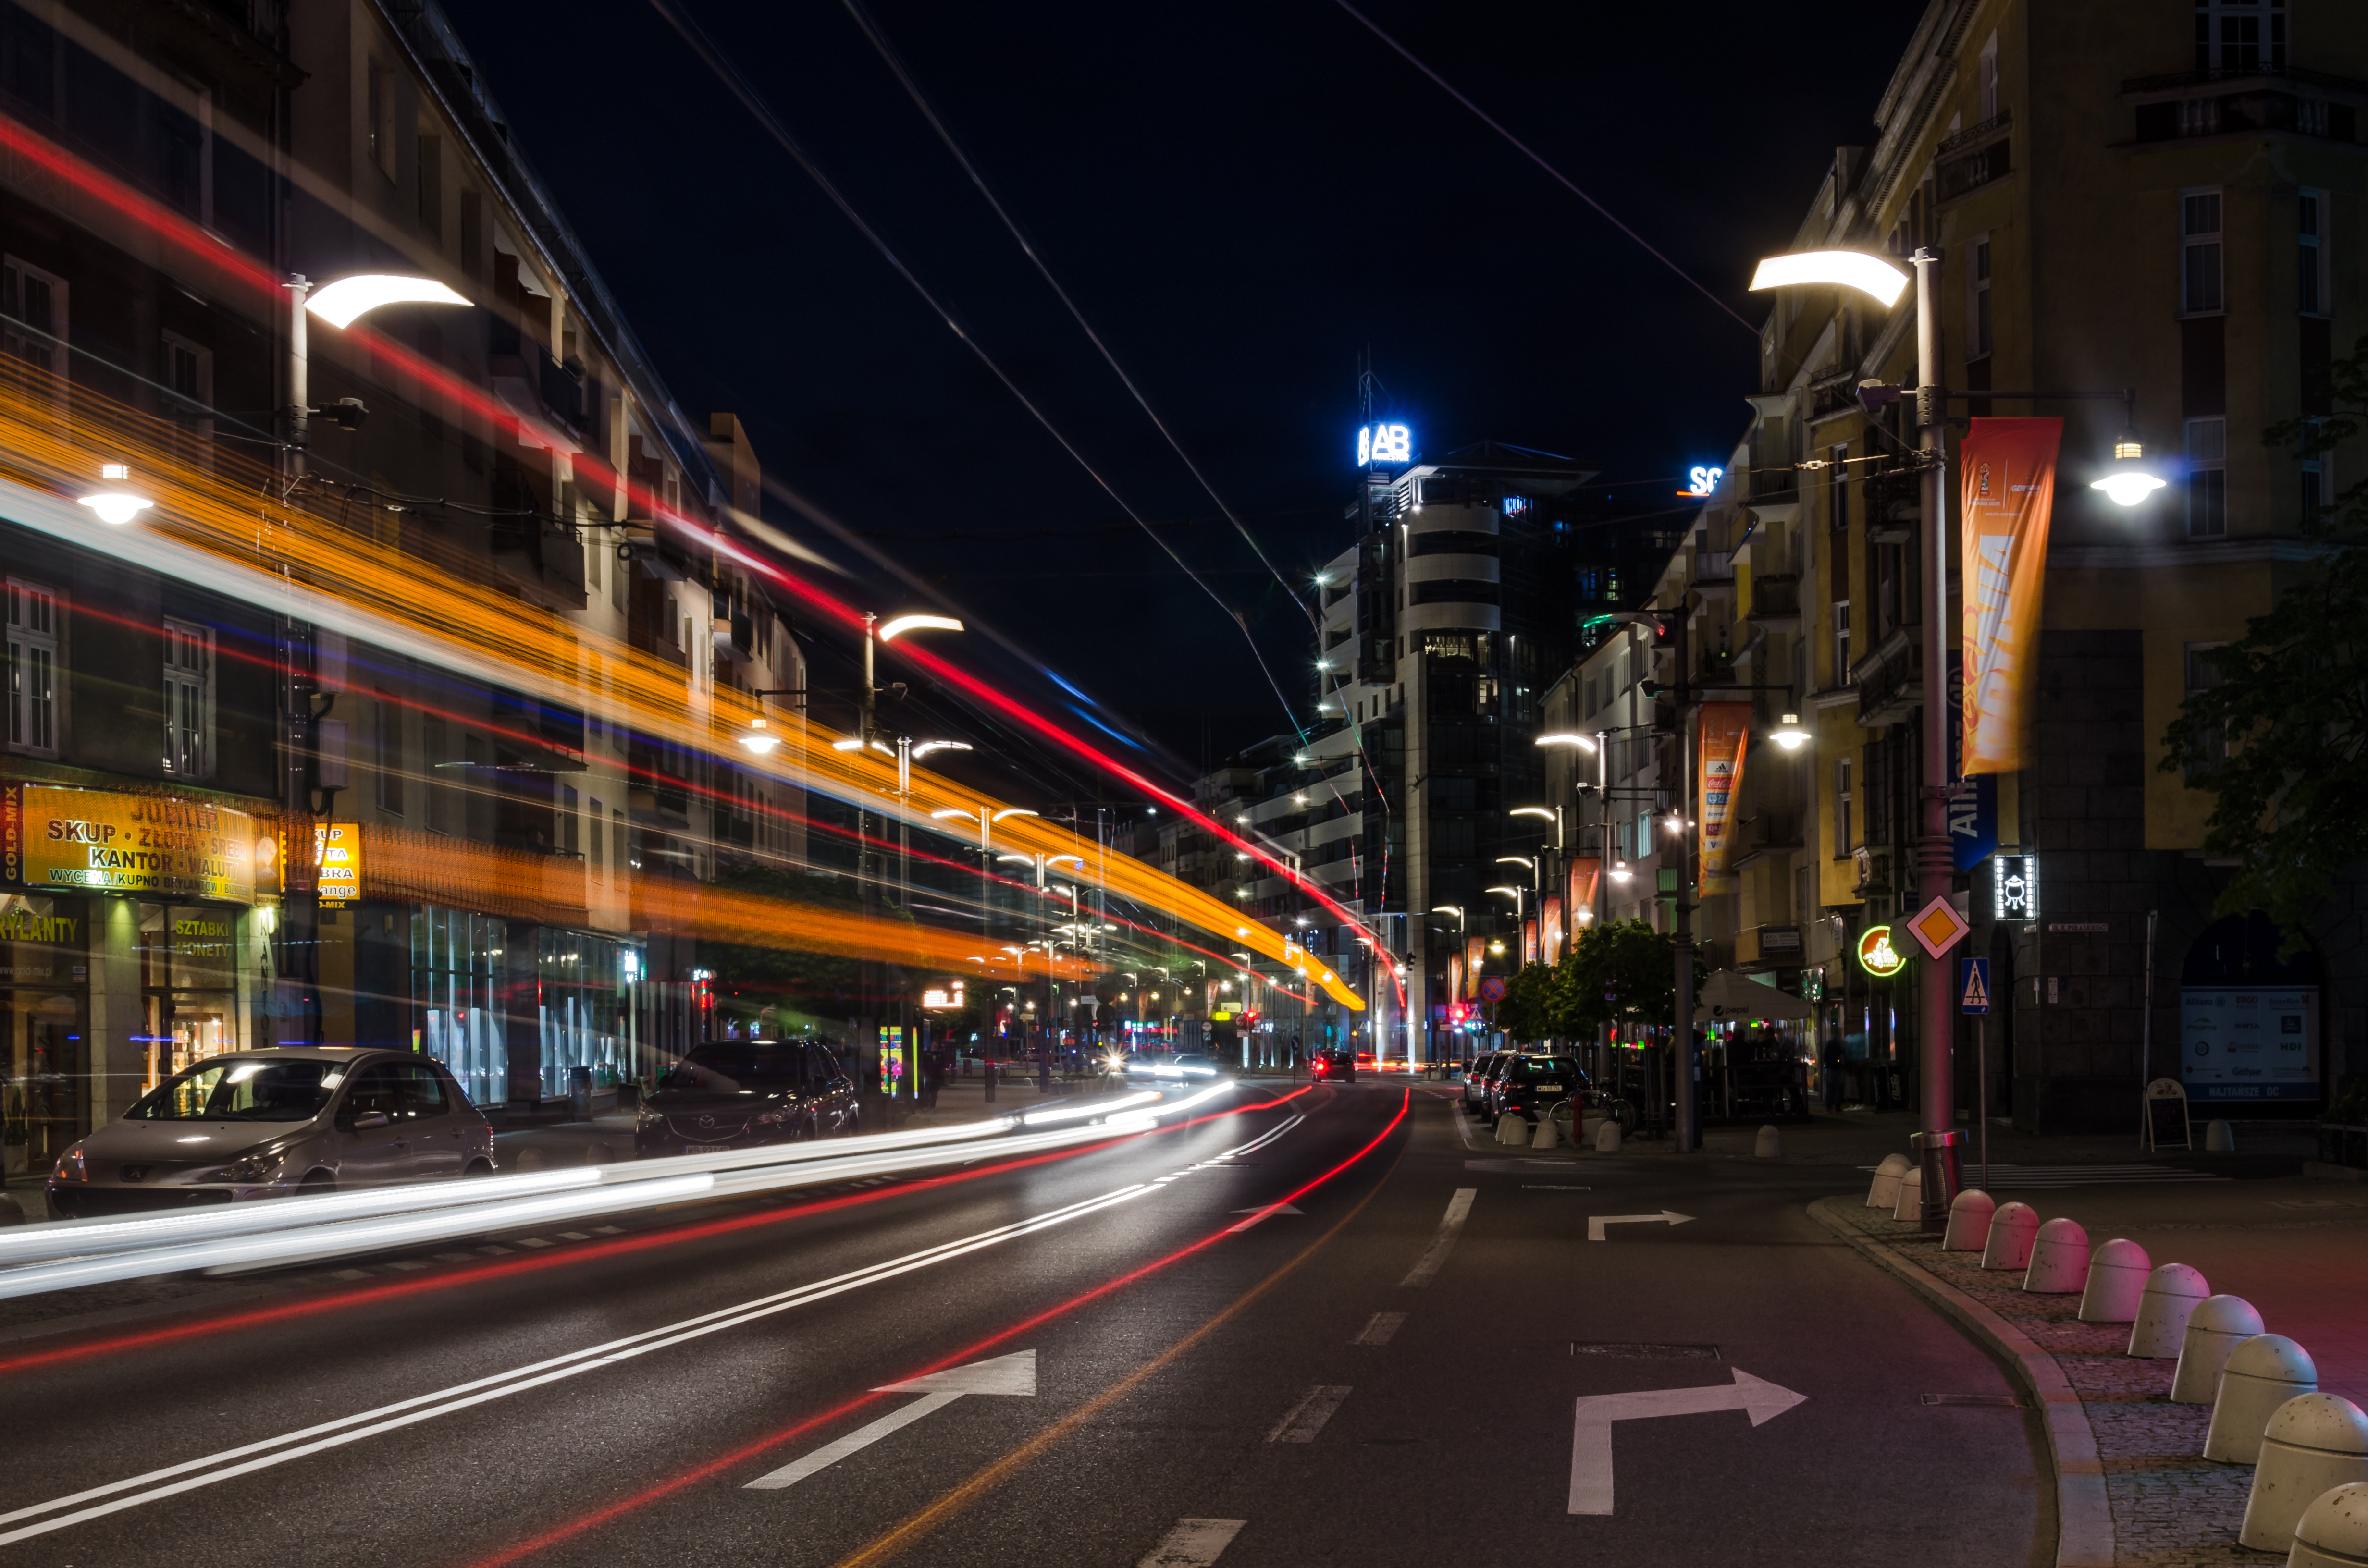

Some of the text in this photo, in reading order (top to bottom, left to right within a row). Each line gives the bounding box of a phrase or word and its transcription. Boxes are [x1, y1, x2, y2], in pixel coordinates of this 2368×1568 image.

[1372, 425, 1409, 453] AB
[6, 786, 17, 880] GOLD-MIX
[47, 819, 116, 844] SKUP
[89, 846, 239, 881] KANTOR WALUTY
[321, 869, 354, 878] BRA
[321, 886, 356, 898] ange
[0, 914, 78, 943] RYLANTY
[176, 919, 229, 937] SZTABKI
[176, 941, 229, 958] MONETY
[2185, 997, 2214, 1006] Allianz
[1726, 1005, 1749, 1015] pepsi
[2281, 1042, 2301, 1051] HDI
[2232, 1067, 2262, 1077] Gothaer
[2209, 1084, 2279, 1097] NAJTAŃSZE OC
